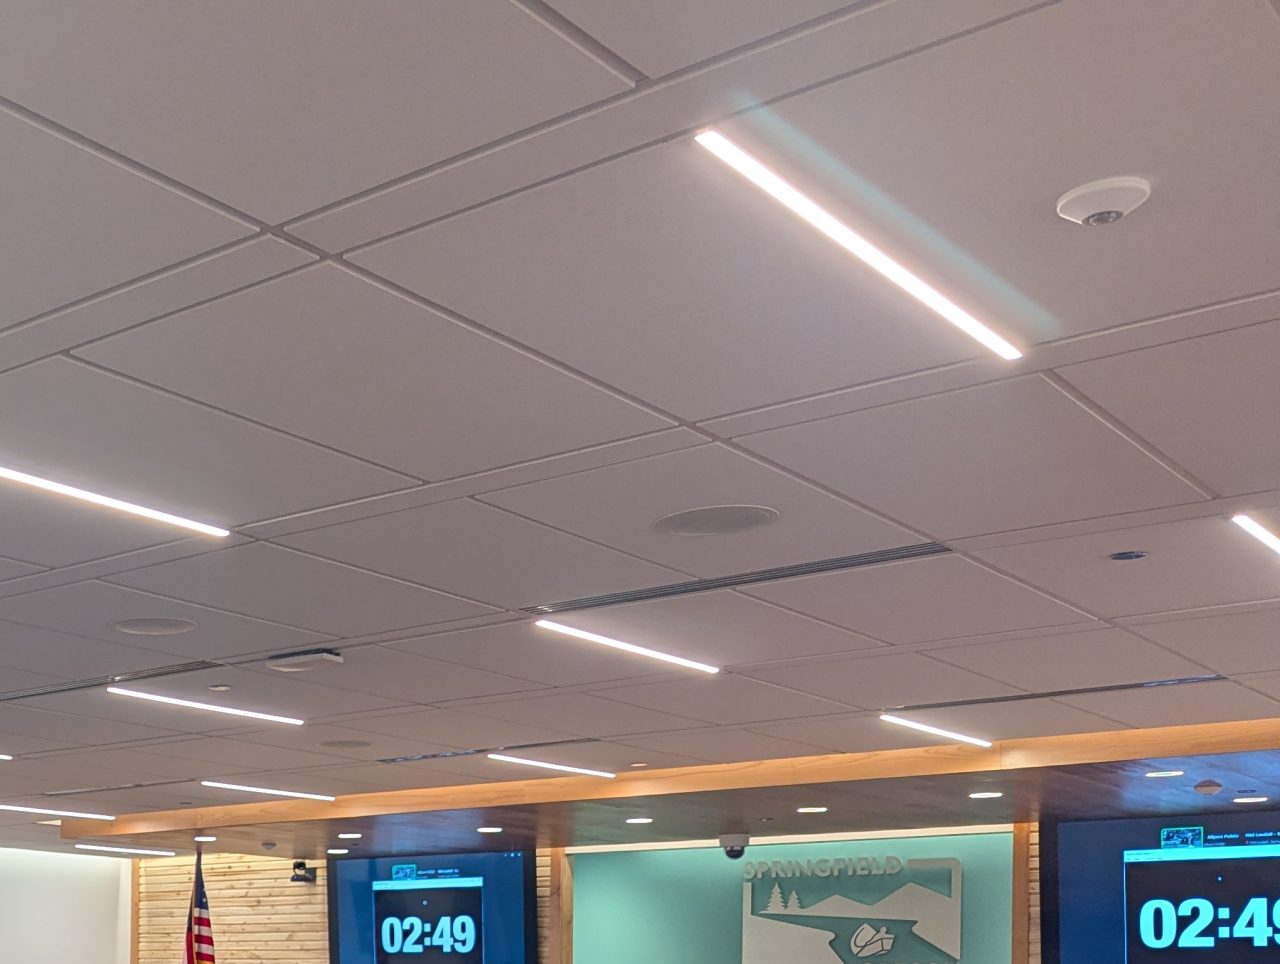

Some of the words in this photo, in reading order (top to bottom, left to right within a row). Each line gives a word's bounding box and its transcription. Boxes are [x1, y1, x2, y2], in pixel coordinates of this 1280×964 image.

[742, 855, 904, 880] SPRINGFIELD
[381, 915, 476, 954] 02:49
[1139, 897, 1280, 949] 02:4
